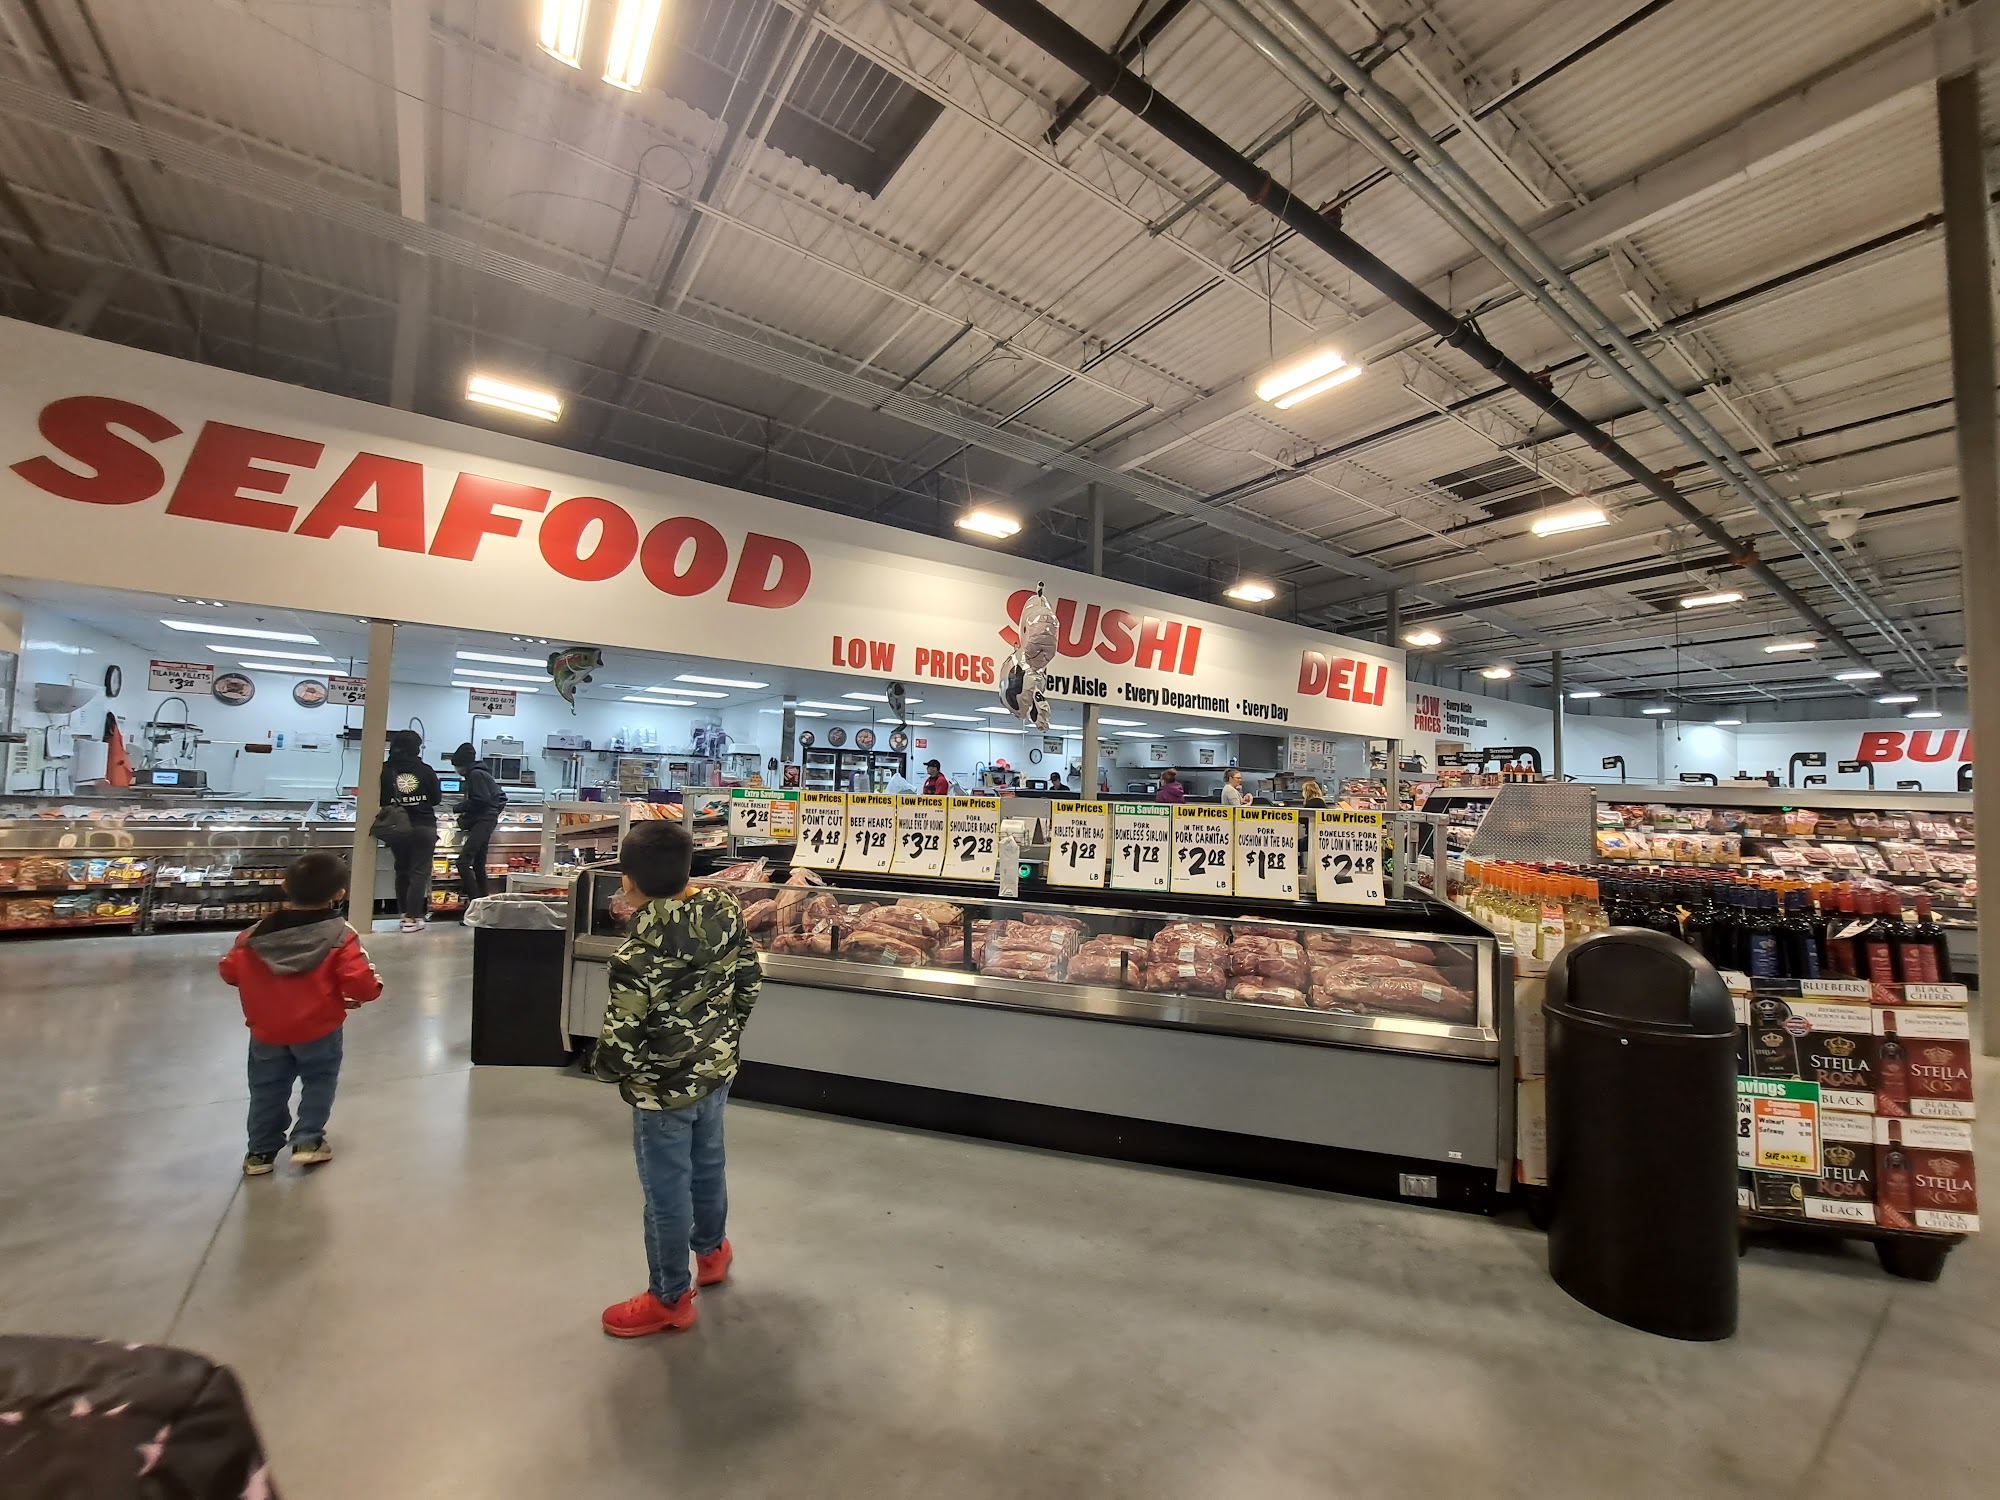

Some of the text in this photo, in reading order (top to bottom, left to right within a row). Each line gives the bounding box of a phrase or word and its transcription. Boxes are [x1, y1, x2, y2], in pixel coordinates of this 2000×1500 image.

[9, 396, 811, 609] SEAFOOD
[832, 635, 995, 685] LOW PRICES
[1298, 649, 1388, 706] DELI
[1046, 674, 1107, 697] ery Aisle
[1125, 683, 1230, 713] Every Department
[1243, 699, 1289, 721] Every Day
[1416, 694, 1440, 716] LOW
[1446, 700, 1460, 712] Every
[1415, 715, 1441, 733] PRICES
[1446, 712, 1460, 724] Every
[1446, 724, 1460, 736] Every
[760, 790, 785, 799] Savings
[804, 793, 842, 803] Low Prices
[852, 795, 892, 804] Low Prices
[901, 796, 942, 806] Low Prices
[953, 798, 996, 808] Low Prices
[1057, 802, 1103, 813] Low Prices
[1115, 805, 1169, 815] Extra Savings
[1178, 807, 1228, 818] Low Prices
[802, 815, 825, 825] POINT
[827, 816, 843, 826] CUT
[1241, 809, 1293, 821] Low Prices
[1321, 812, 1376, 824] Low Prices
[850, 817, 892, 828] BEEF HEARTS
[950, 821, 997, 833] SHOULDER ROAST
[1054, 826, 1104, 839] RIBLETS IN THE BAG
[1115, 829, 1168, 842] BONELESS SIRLOIN
[1175, 831, 1229, 845] PORK CARNITAS
[1319, 830, 1377, 839] BONELESS PORK
[1239, 834, 1294, 848] CUSHION IN THE BAG
[1319, 838, 1378, 852] TOP LOIN IN THE BAG
[1154, 877, 1164, 885] LB
[1216, 880, 1226, 888] LB
[1366, 890, 1378, 898] LB
[1803, 981, 1867, 993] BLUEBERRY
[1810, 1054, 1870, 1072] STELLA
[1816, 1069, 1867, 1086] ROSA
[1910, 1064, 1968, 1080] STELLA
[1737, 1080, 1786, 1096] avings
[1822, 1095, 1864, 1106] BLACK
[1759, 1117, 1785, 1125] Walmart
[1759, 1126, 1785, 1135] Safeway
[1823, 1166, 1869, 1183] TELLA
[1817, 1181, 1866, 1196] ROSA
[1915, 1174, 1973, 1192] STELLA
[1821, 1204, 1863, 1217] BLACK
[1929, 1212, 1965, 1221] BLACK
[1925, 1220, 1968, 1230] CHERRY
